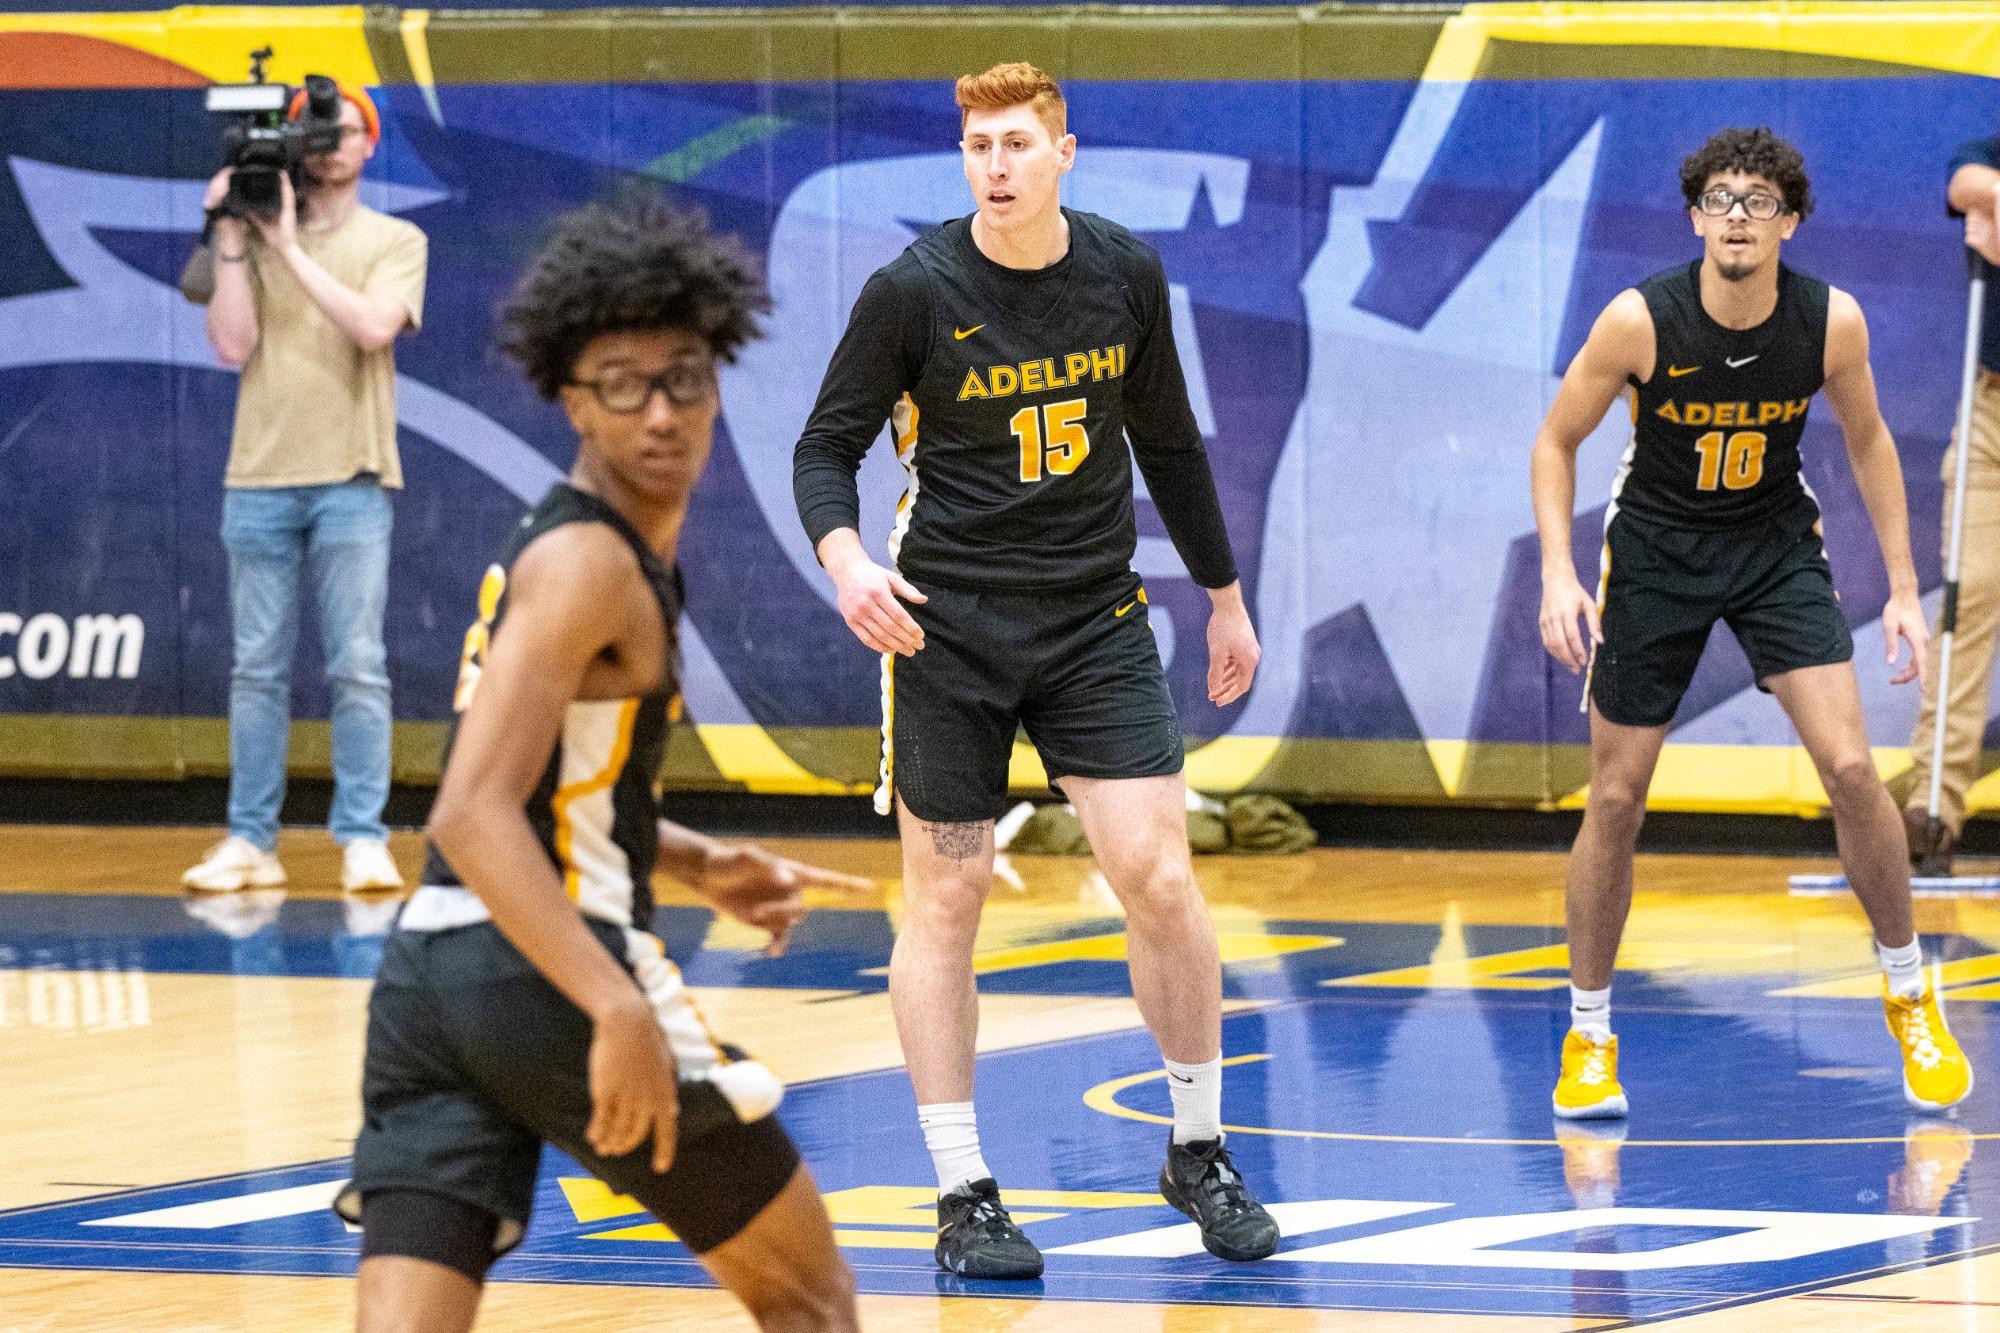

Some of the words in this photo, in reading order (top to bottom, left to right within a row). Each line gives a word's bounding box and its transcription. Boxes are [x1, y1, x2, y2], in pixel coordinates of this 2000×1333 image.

[956, 343, 1126, 401] ADELPHI
[1009, 397, 1090, 483] 15
[1655, 397, 1809, 426] ADELPH
[1694, 430, 1768, 491] 10
